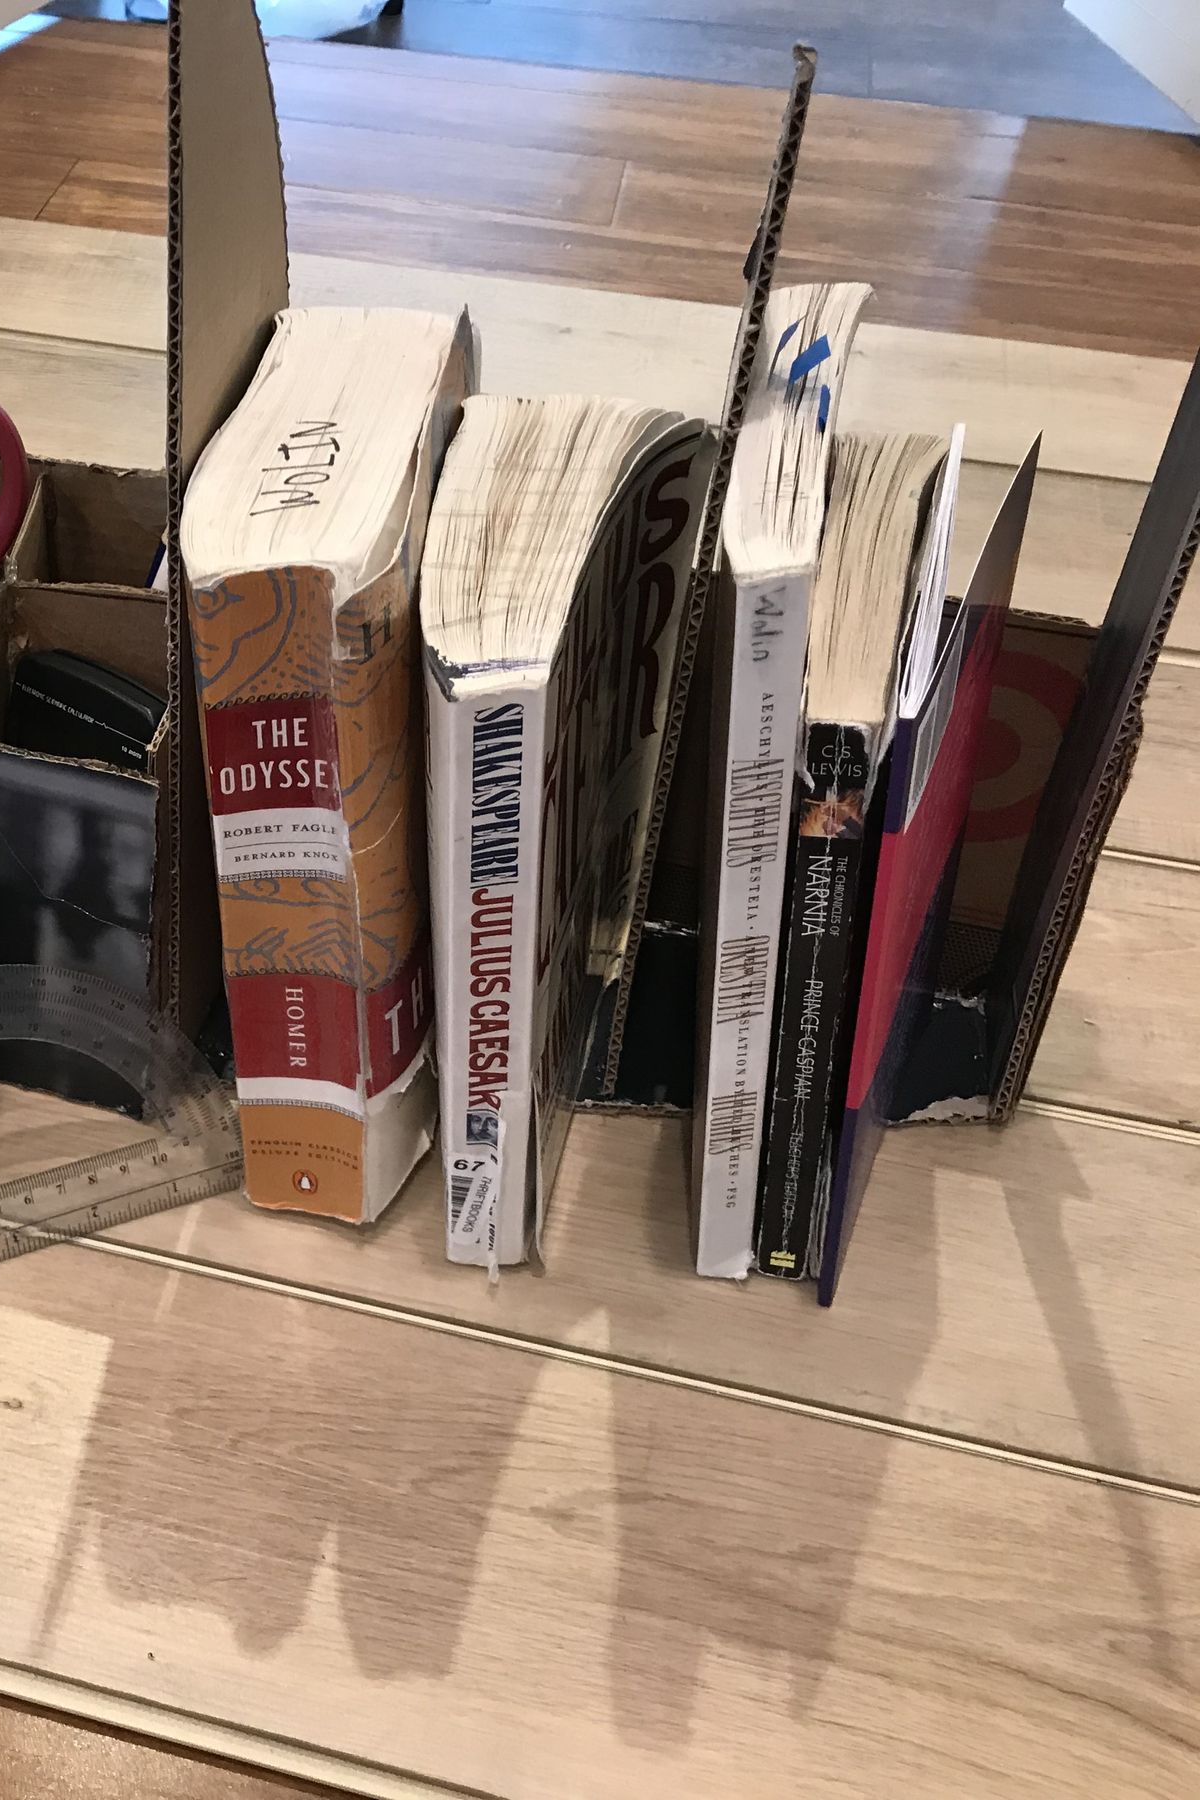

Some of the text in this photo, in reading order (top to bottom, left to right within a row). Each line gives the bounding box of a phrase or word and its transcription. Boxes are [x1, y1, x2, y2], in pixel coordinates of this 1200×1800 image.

[251, 717, 309, 749] THE
[811, 762, 863, 777] LEWIS
[470, 703, 525, 884] SHAKESPEARE
[223, 823, 338, 839] ROBERT FAGLE
[234, 851, 339, 863] BERNARD KNOX
[801, 855, 834, 937] NARNIA
[829, 856, 849, 937] THE CHRONICLES OF
[469, 888, 514, 998] JULIUS
[71, 984, 88, 996] 120
[109, 1000, 126, 1012] 130
[384, 966, 425, 1056] TH
[284, 986, 308, 1067] HOMER
[793, 979, 824, 1100] PRINCE CASPIAN
[250, 1139, 359, 1162] PENGUIN CLASSICS
[251, 1149, 359, 1170] DELUXE EDITION
[453, 1159, 486, 1172] 67
[23, 1195, 32, 1206] 6
[55, 1183, 63, 1195] 7
[87, 1174, 96, 1185] 8
[119, 1164, 127, 1175] 9
[462, 1175, 492, 1233] THRIFTBOOKS
